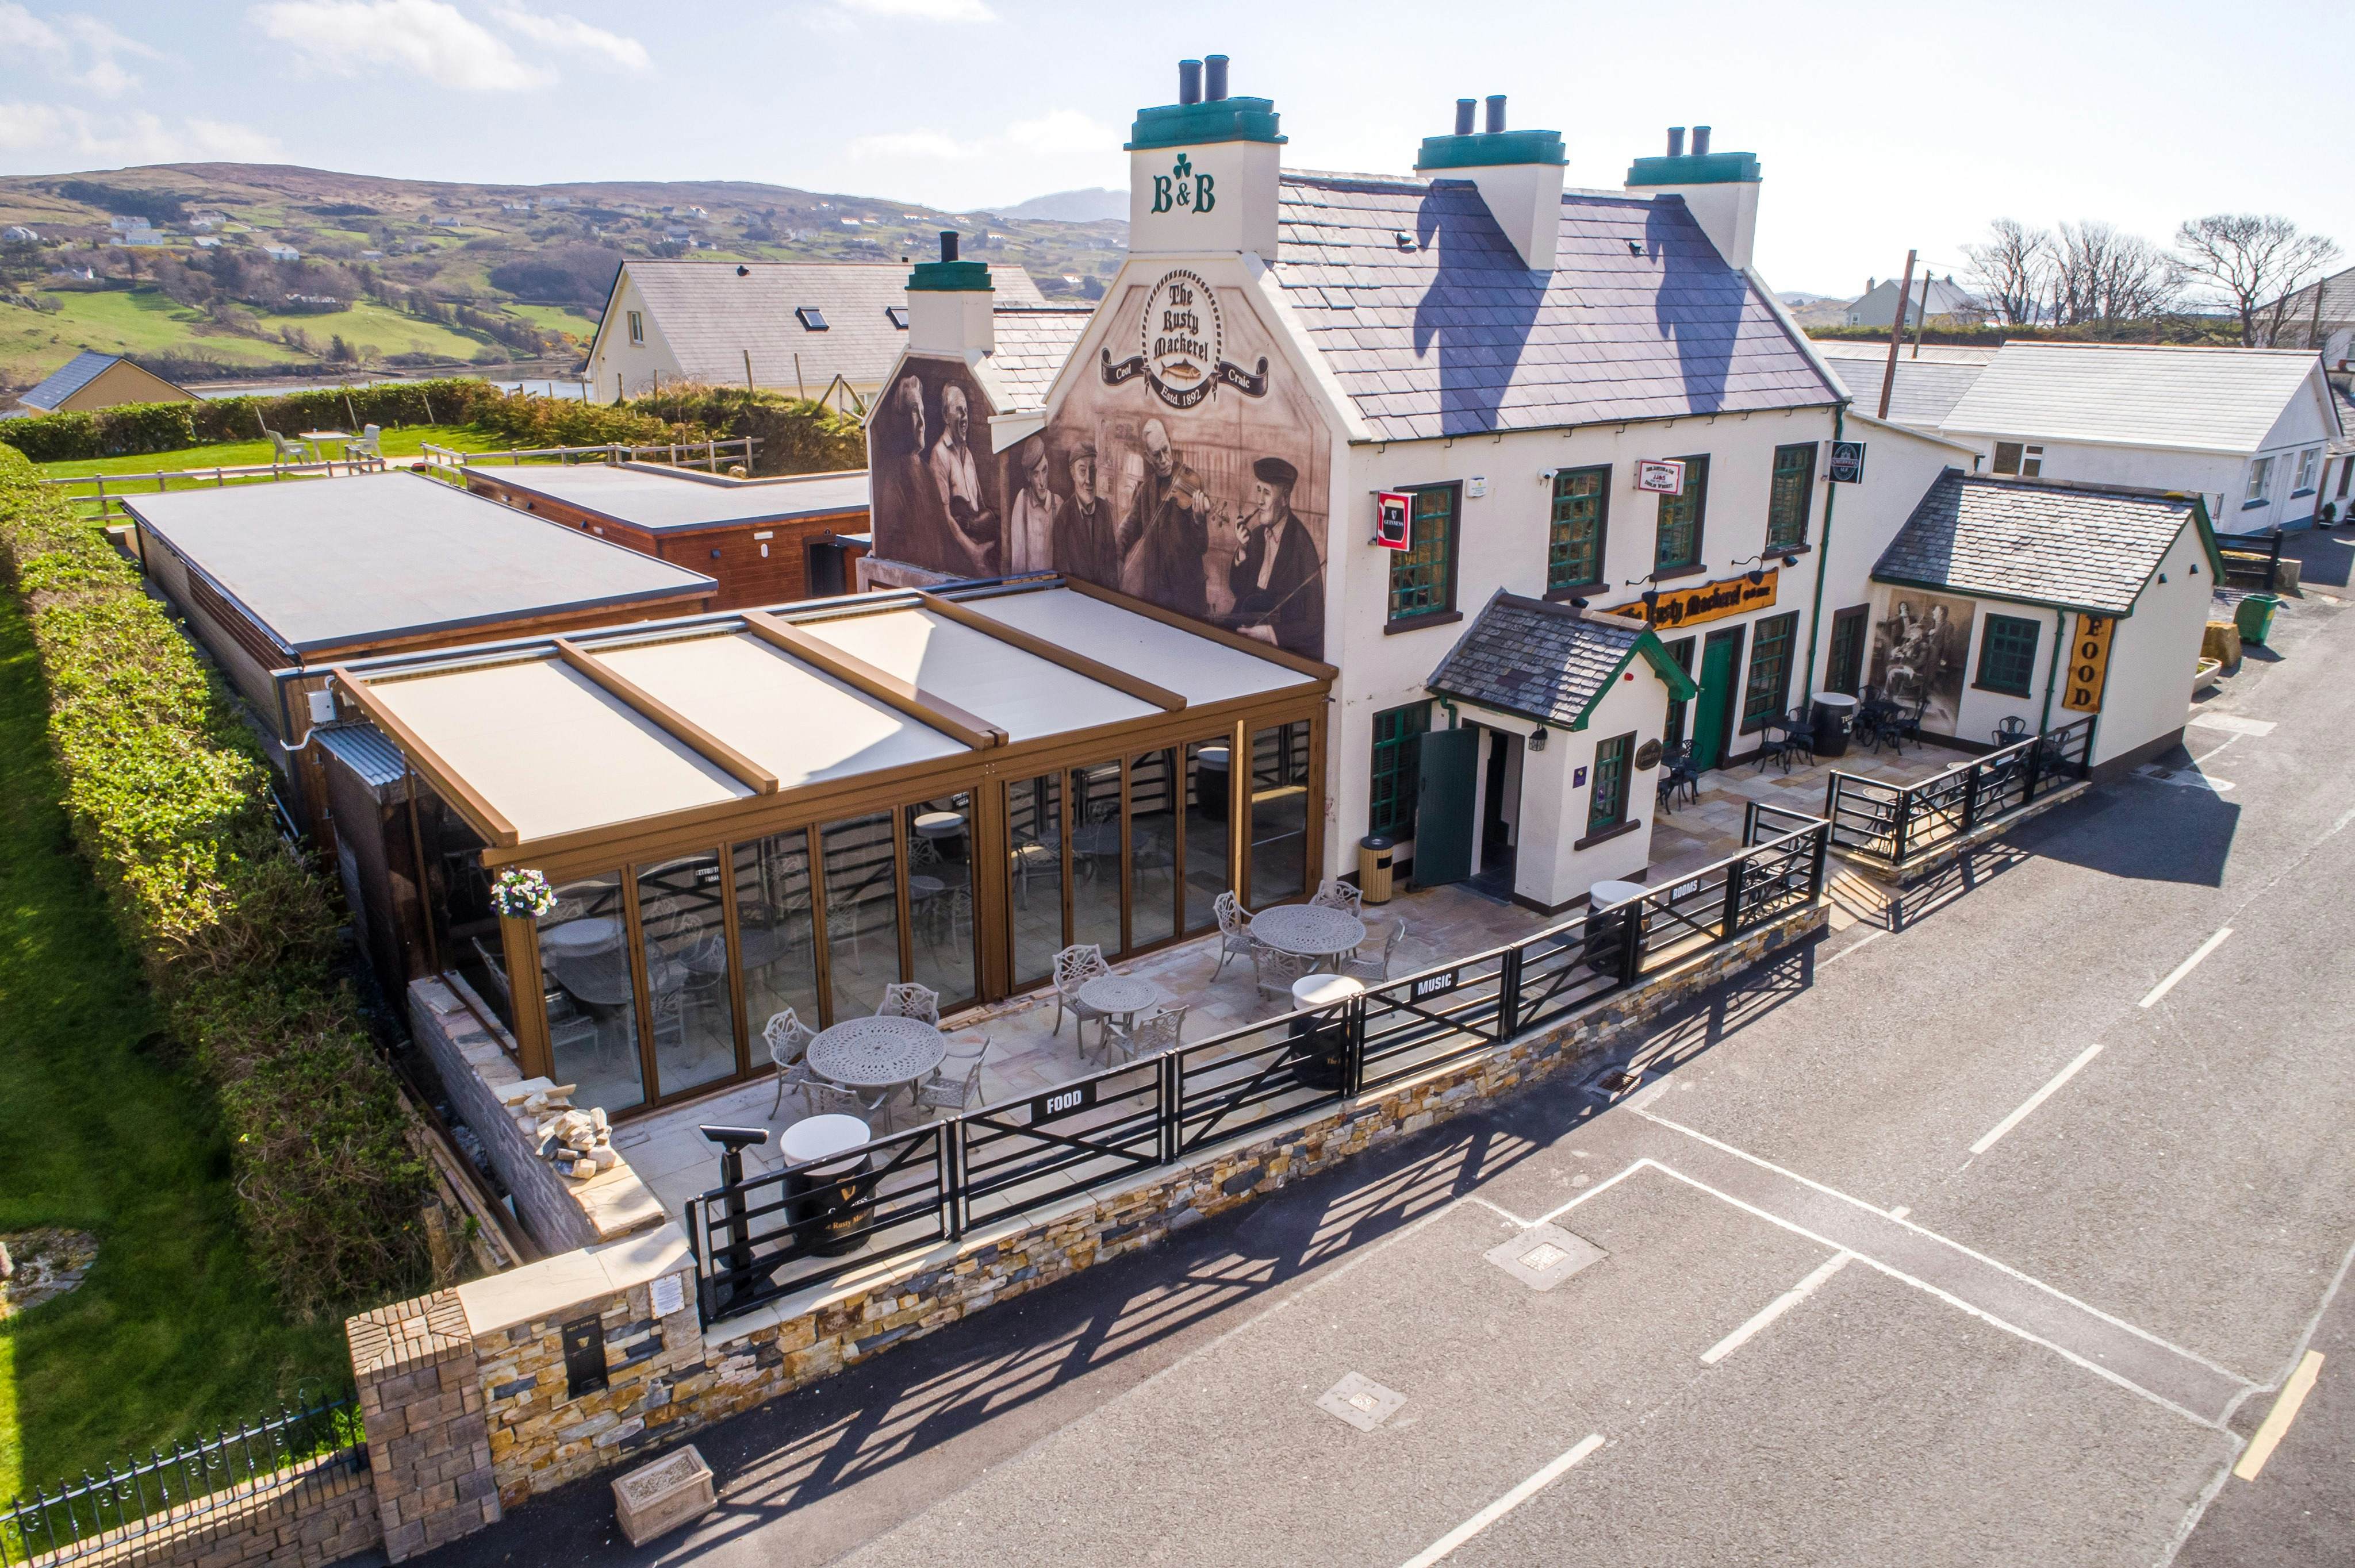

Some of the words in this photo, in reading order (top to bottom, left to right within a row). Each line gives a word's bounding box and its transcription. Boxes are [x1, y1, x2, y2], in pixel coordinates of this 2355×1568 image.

[1151, 174, 1215, 214] B&B
[1169, 282, 1193, 306] The
[1163, 309, 1199, 336] Rusty
[1153, 332, 1209, 362] Mackerel
[1116, 364, 1132, 379] Ceol
[1228, 369, 1251, 389] Craic
[1160, 386, 1180, 406] Estd.
[1182, 389, 1202, 406] 1892
[2072, 614, 2103, 706] FOOD
[1673, 879, 1698, 900] ROOMS
[1418, 973, 1452, 996] MUSIC
[1047, 1090, 1081, 1114] FOOD
[833, 1220, 851, 1229] Rusty
